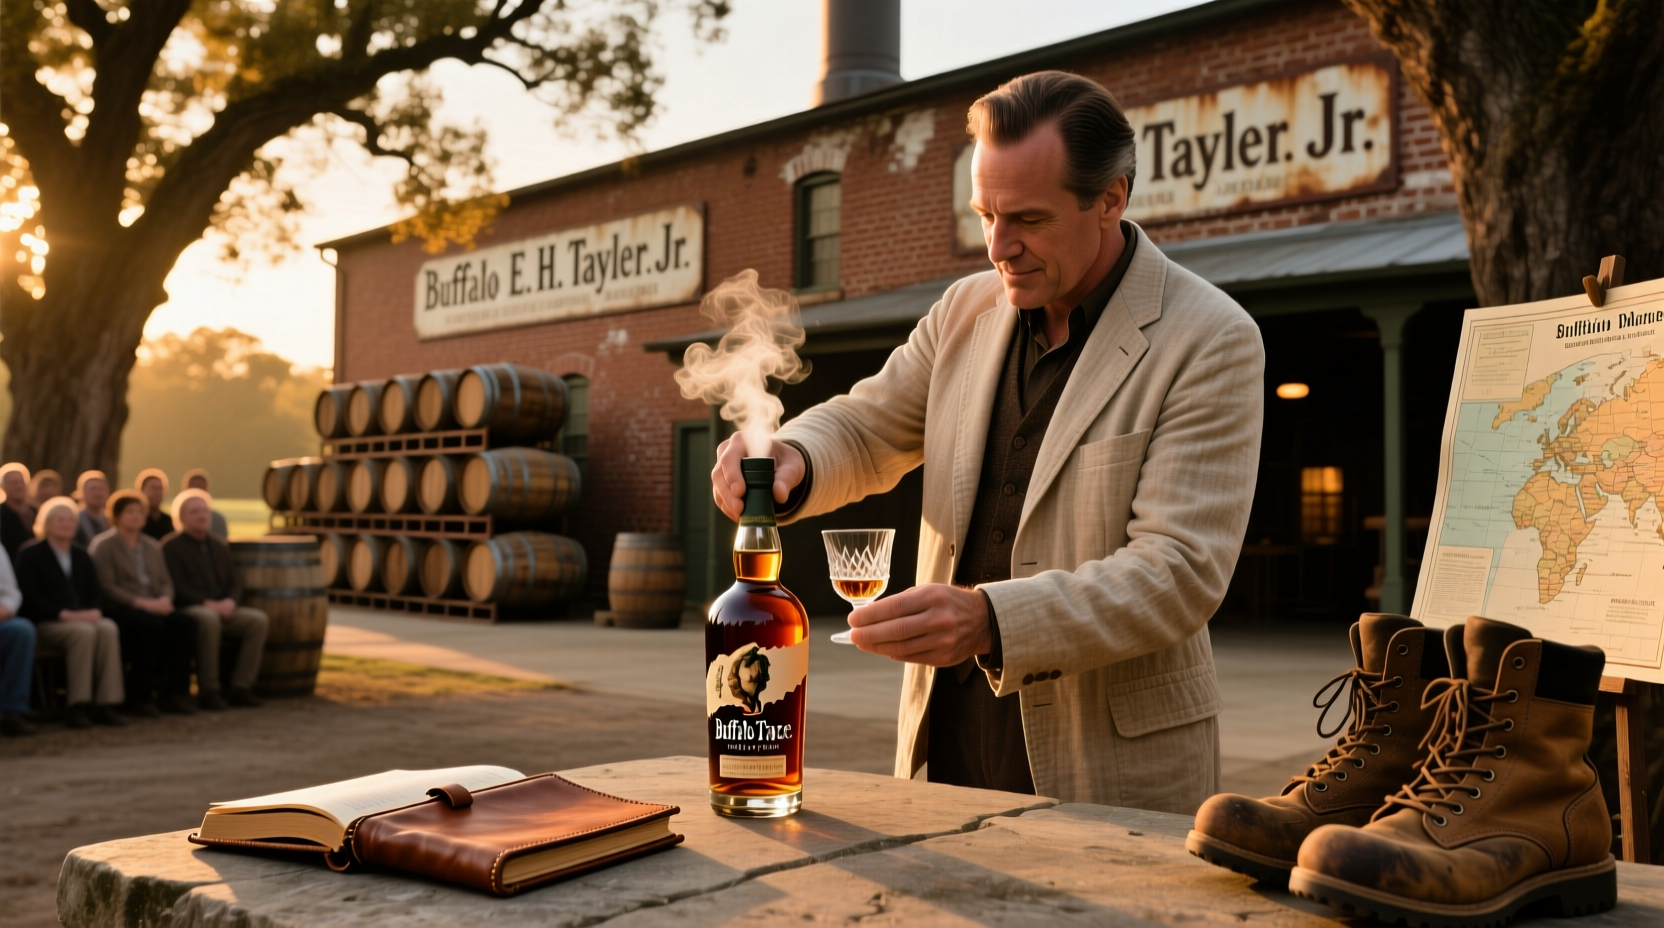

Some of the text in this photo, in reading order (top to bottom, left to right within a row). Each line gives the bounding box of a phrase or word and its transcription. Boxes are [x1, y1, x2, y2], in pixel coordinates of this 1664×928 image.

[1142, 92, 1374, 191] Tayler. Jr.
[424, 259, 500, 312] Buffalo
[508, 250, 532, 297] E.
[537, 243, 563, 292] H.
[567, 232, 652, 295] Tayler.
[655, 221, 691, 273] Jr.
